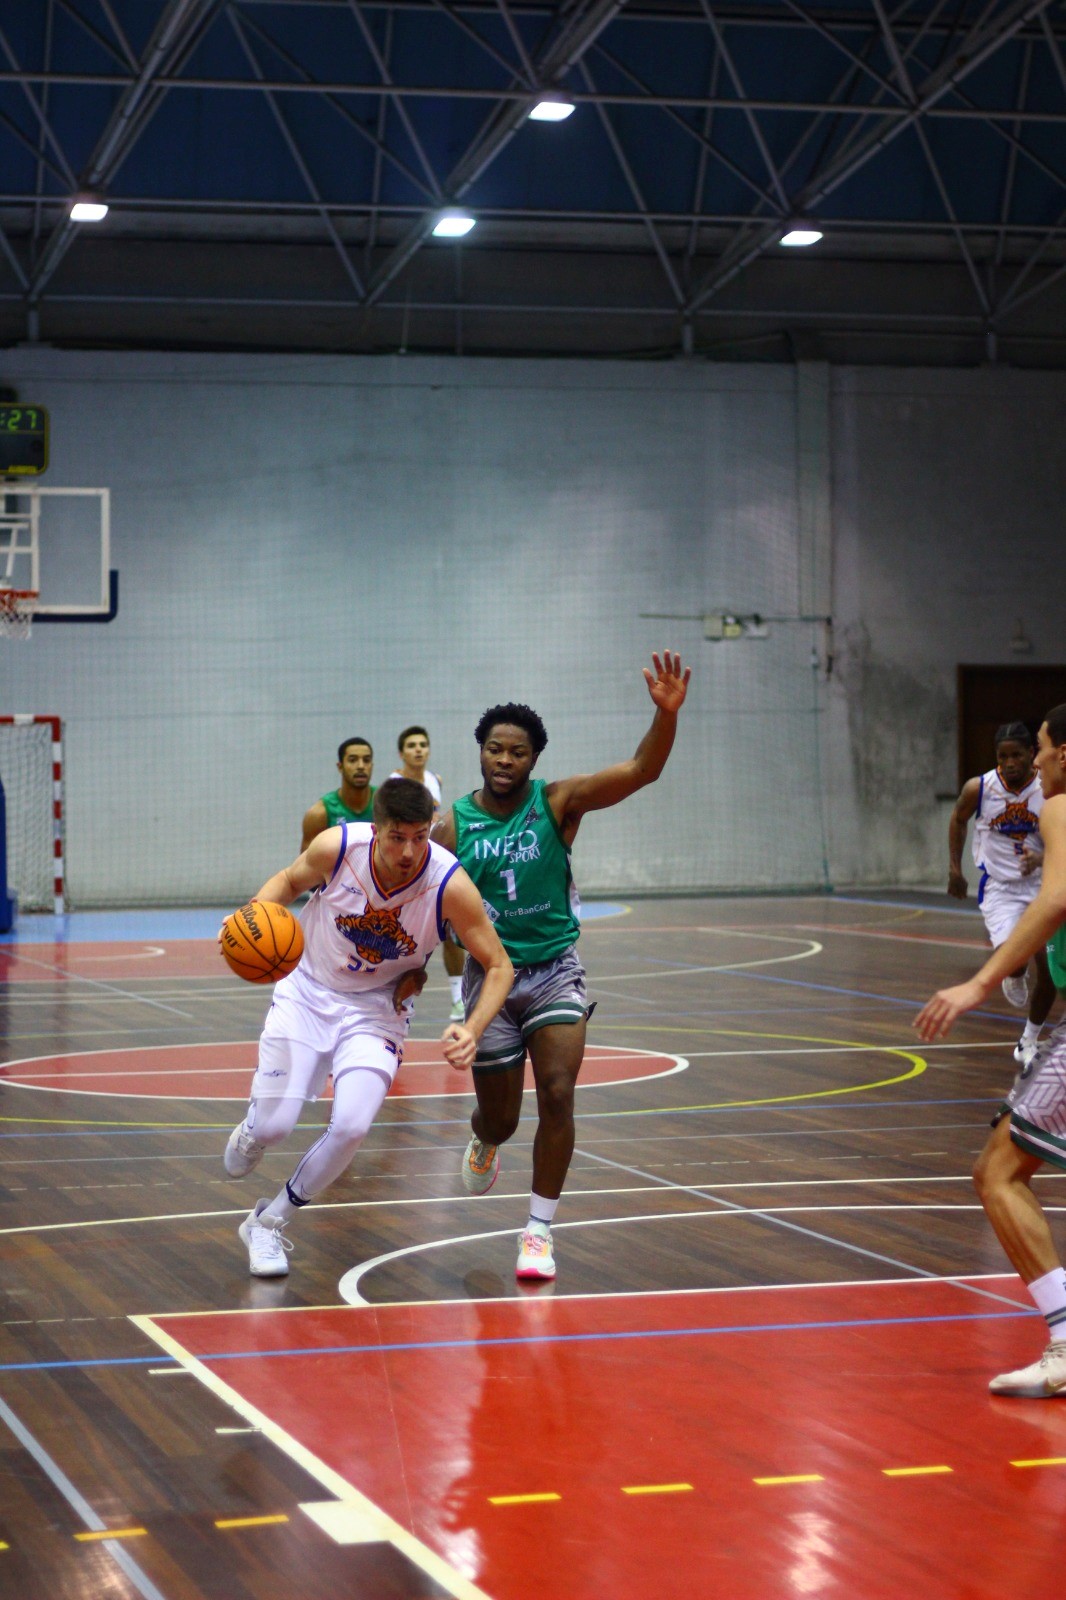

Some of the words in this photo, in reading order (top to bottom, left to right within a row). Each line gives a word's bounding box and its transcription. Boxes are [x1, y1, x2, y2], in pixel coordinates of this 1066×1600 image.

[508, 844, 541, 864] SPORT
[500, 868, 517, 901] 1
[504, 900, 551, 918] FerBanCozi
